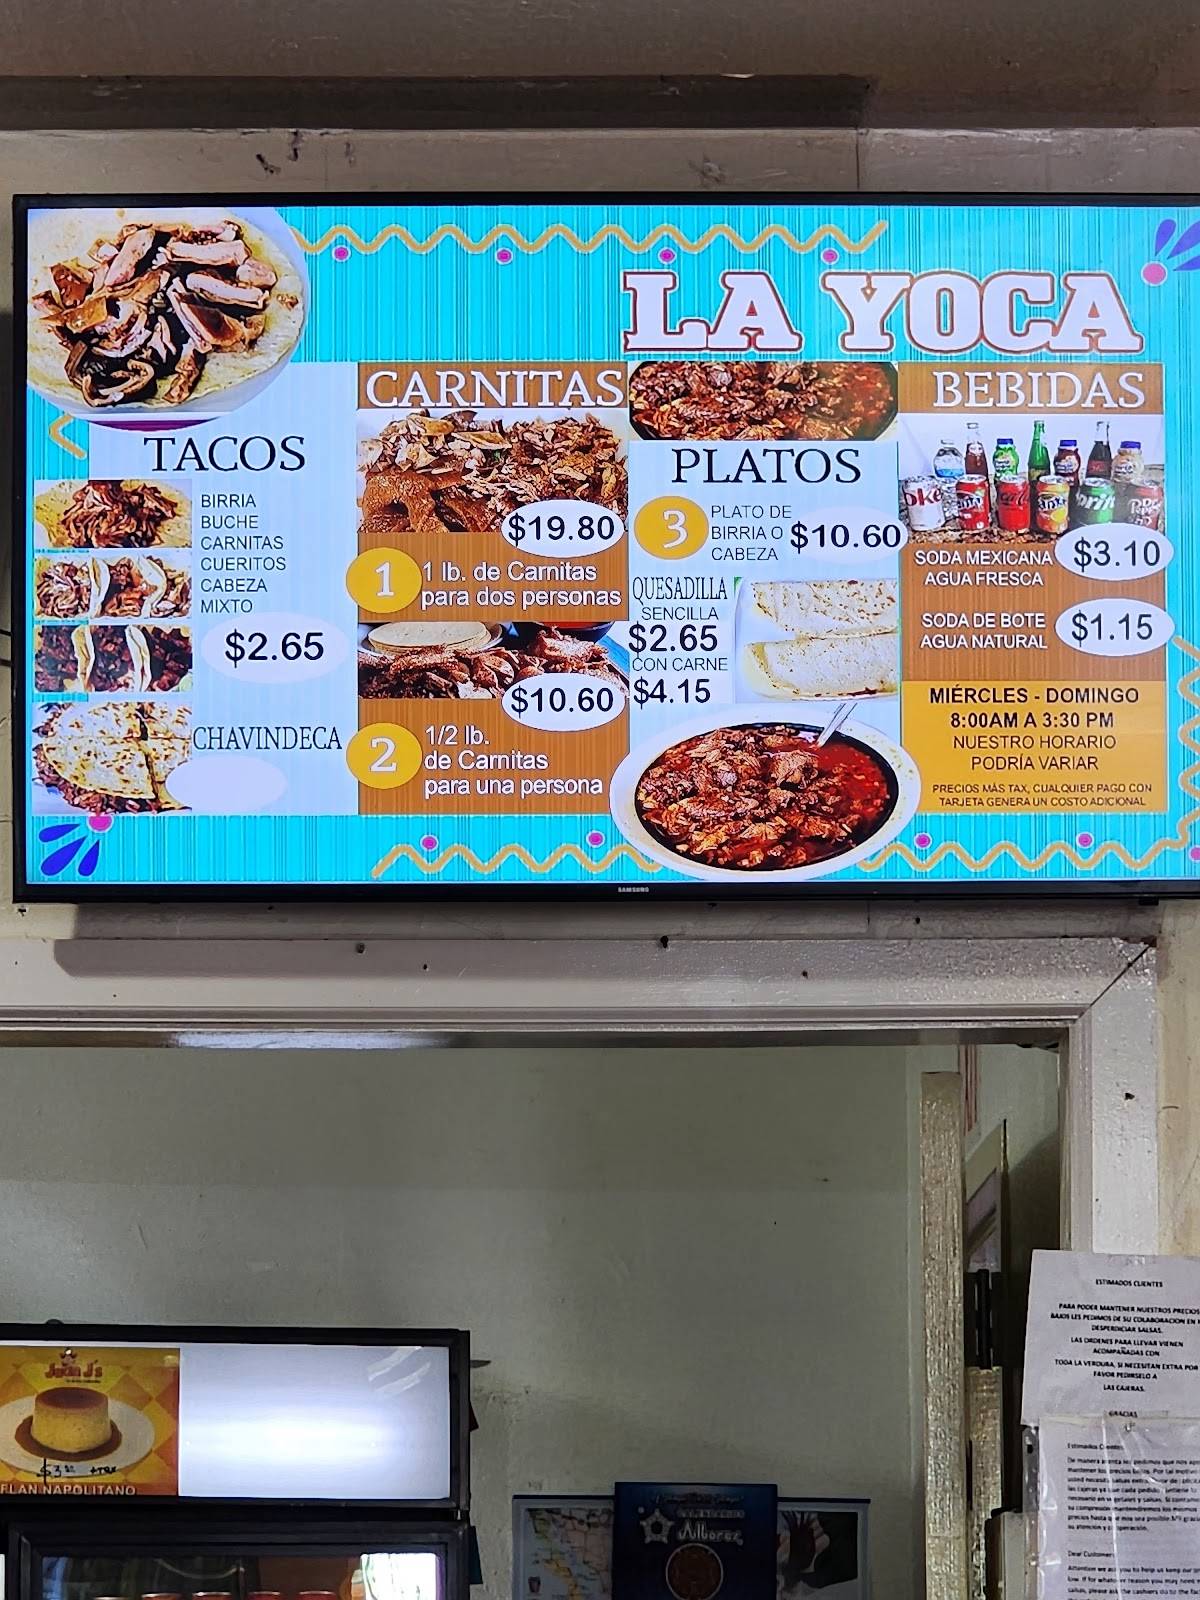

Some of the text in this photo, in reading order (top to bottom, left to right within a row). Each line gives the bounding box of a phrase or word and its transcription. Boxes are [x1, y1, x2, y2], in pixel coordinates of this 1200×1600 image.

[623, 271, 1145, 354] LA YOCA
[366, 370, 625, 409] CARNITAS
[933, 370, 1145, 409] BEBIDAS
[143, 436, 306, 473] TACOS
[671, 448, 862, 484] PLATOS
[200, 493, 257, 509] BIRRIA
[904, 488, 942, 506] oke
[711, 505, 792, 519] PLATO DE
[200, 514, 259, 530] BUCHE
[507, 512, 616, 545] $19.80
[662, 509, 689, 549] 3
[711, 526, 784, 540] BIRRIA O
[789, 520, 901, 554] $10.60
[200, 535, 284, 551] CARNITAS
[711, 547, 779, 561] CABEZA
[915, 550, 1053, 566] SODA MEXICANA
[1073, 536, 1161, 573] $3.10
[200, 556, 287, 572] CUERITOS
[423, 561, 597, 582] 1 lb. de Carnitas
[200, 577, 268, 594] CABEZA
[375, 561, 395, 598] 1
[924, 571, 1044, 587] AGUA FRESCA
[421, 587, 622, 610] para dos personas
[632, 576, 728, 606] QUESADILLA
[200, 599, 254, 615] MIXTO
[641, 606, 719, 621] SENCILLA
[921, 613, 1046, 629] SODA DE BOTE
[1071, 609, 1154, 648] $1.15
[628, 620, 719, 659] $2.65
[920, 634, 1048, 650] AGUA NATURAL
[224, 629, 325, 668] $2.65
[632, 657, 729, 671] CON CARNE
[633, 676, 711, 710] $4.15
[929, 685, 1028, 704] MIÉRCLES
[1046, 688, 1140, 704] DOMINGO
[511, 685, 615, 719] $10.60
[950, 712, 1114, 729] 8:00AM A 3:30 PM
[193, 725, 343, 752] CHAVINDECA
[424, 725, 490, 747] 1/2 lb.
[953, 735, 1116, 749] NUESTRO HORARIO
[368, 737, 398, 774] 2
[424, 750, 549, 771] de Carnitas
[971, 753, 1099, 770] PODRÍA VARIAR
[424, 779, 603, 798] para una persona
[932, 782, 1152, 794] PRECIOS MÁS TAX, CUALQUIER PAGO CON
[939, 797, 1146, 808] TARJETA GENERA UN COSTO ADICIONAL
[1095, 1278, 1163, 1288] ESTIMADOS CLIENTES
[1077, 1303, 1098, 1311] PODER
[1099, 1304, 1135, 1312] MANTENER
[1136, 1306, 1171, 1314] NUESTROS
[1091, 1324, 1136, 1332] DESPERDICIAR
[1133, 1316, 1185, 1324] COLABORACION
[1083, 1337, 1113, 1345] ORDENES
[1055, 1358, 1073, 1366] TODA
[1074, 1359, 1083, 1367] LA
[1093, 1370, 1115, 1378] FAVOR
[1103, 1383, 1115, 1391] LAS
[1108, 1410, 1139, 1419] GRACIAS
[1, 1483, 136, 1496] FLAN NAPOLITANO
